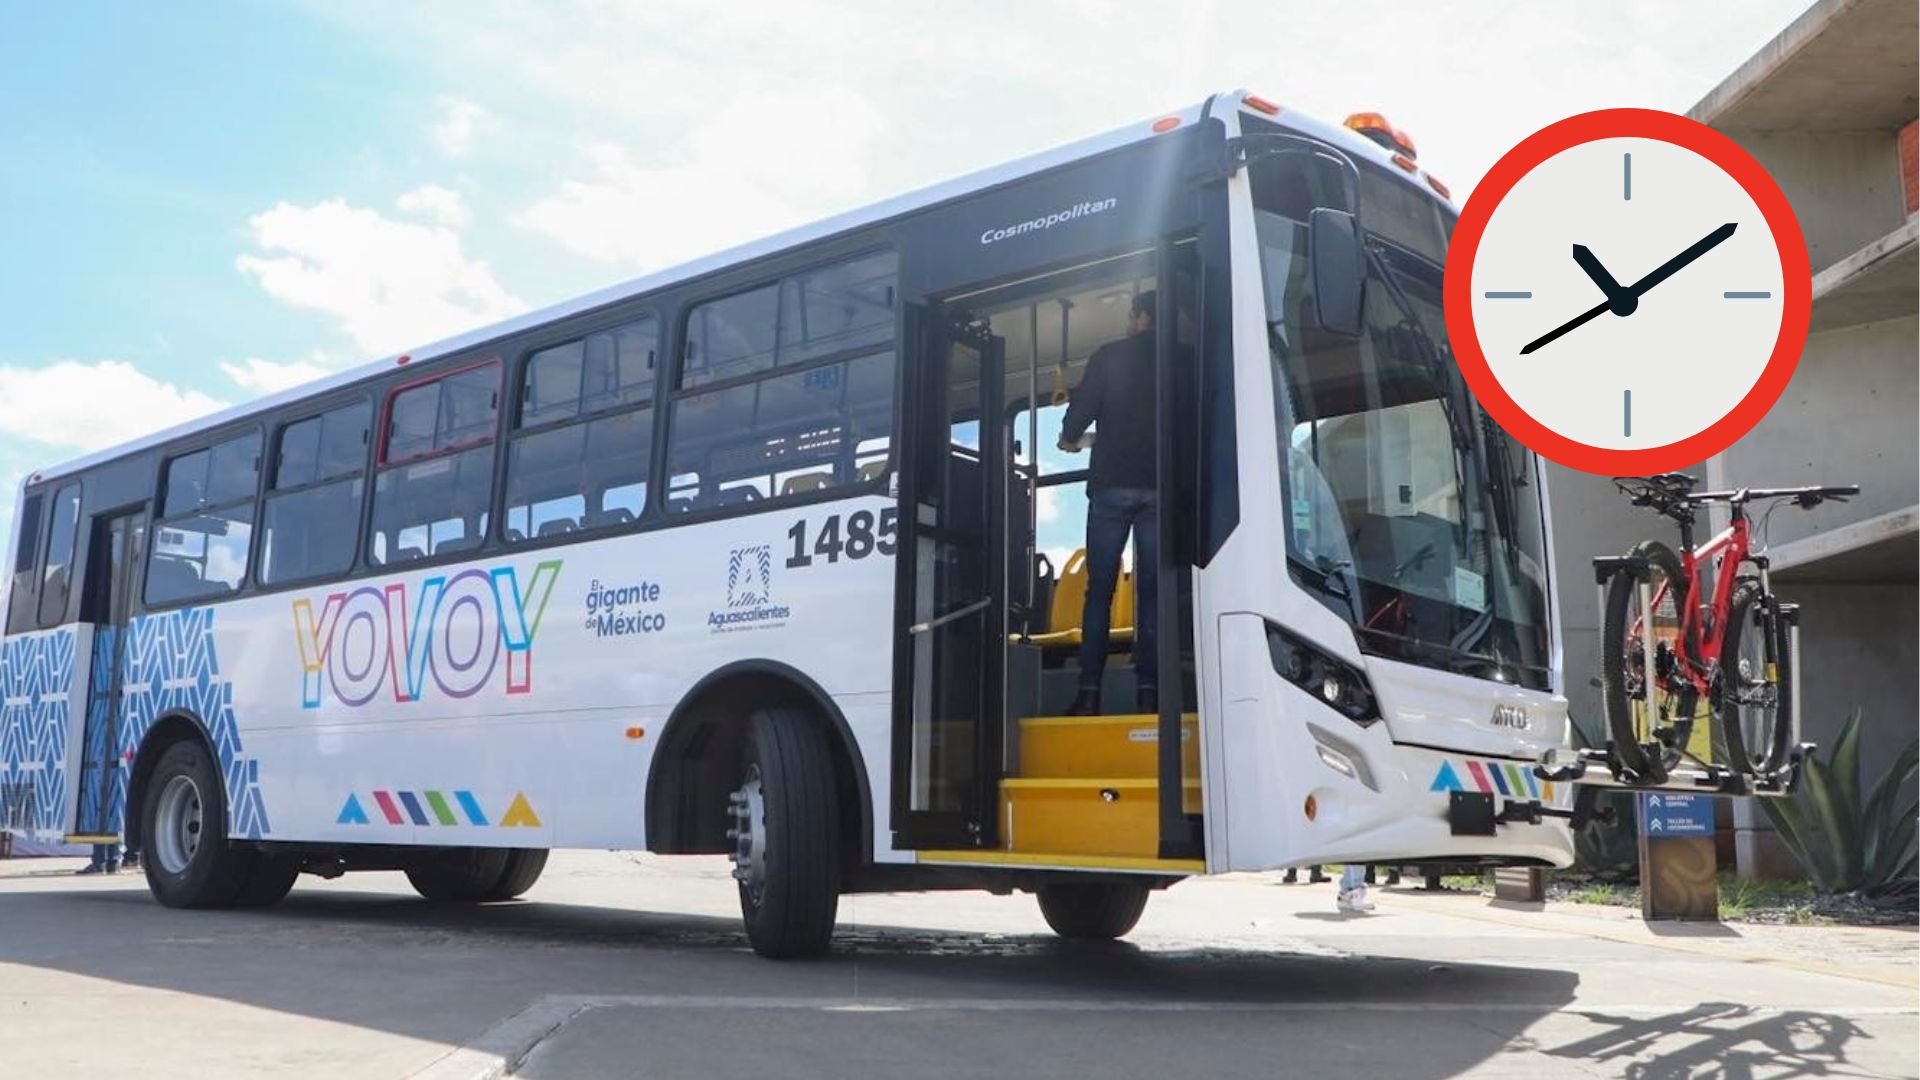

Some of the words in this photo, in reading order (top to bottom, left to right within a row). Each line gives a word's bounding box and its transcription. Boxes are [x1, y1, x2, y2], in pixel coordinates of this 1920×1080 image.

[981, 197, 1117, 244] Cosmopolitan
[786, 507, 899, 568] 1485
[587, 581, 660, 615] gigante
[707, 605, 790, 628] Aguascalientes
[292, 559, 564, 709] YOVOY
[585, 617, 597, 629] de
[597, 610, 665, 637] México
